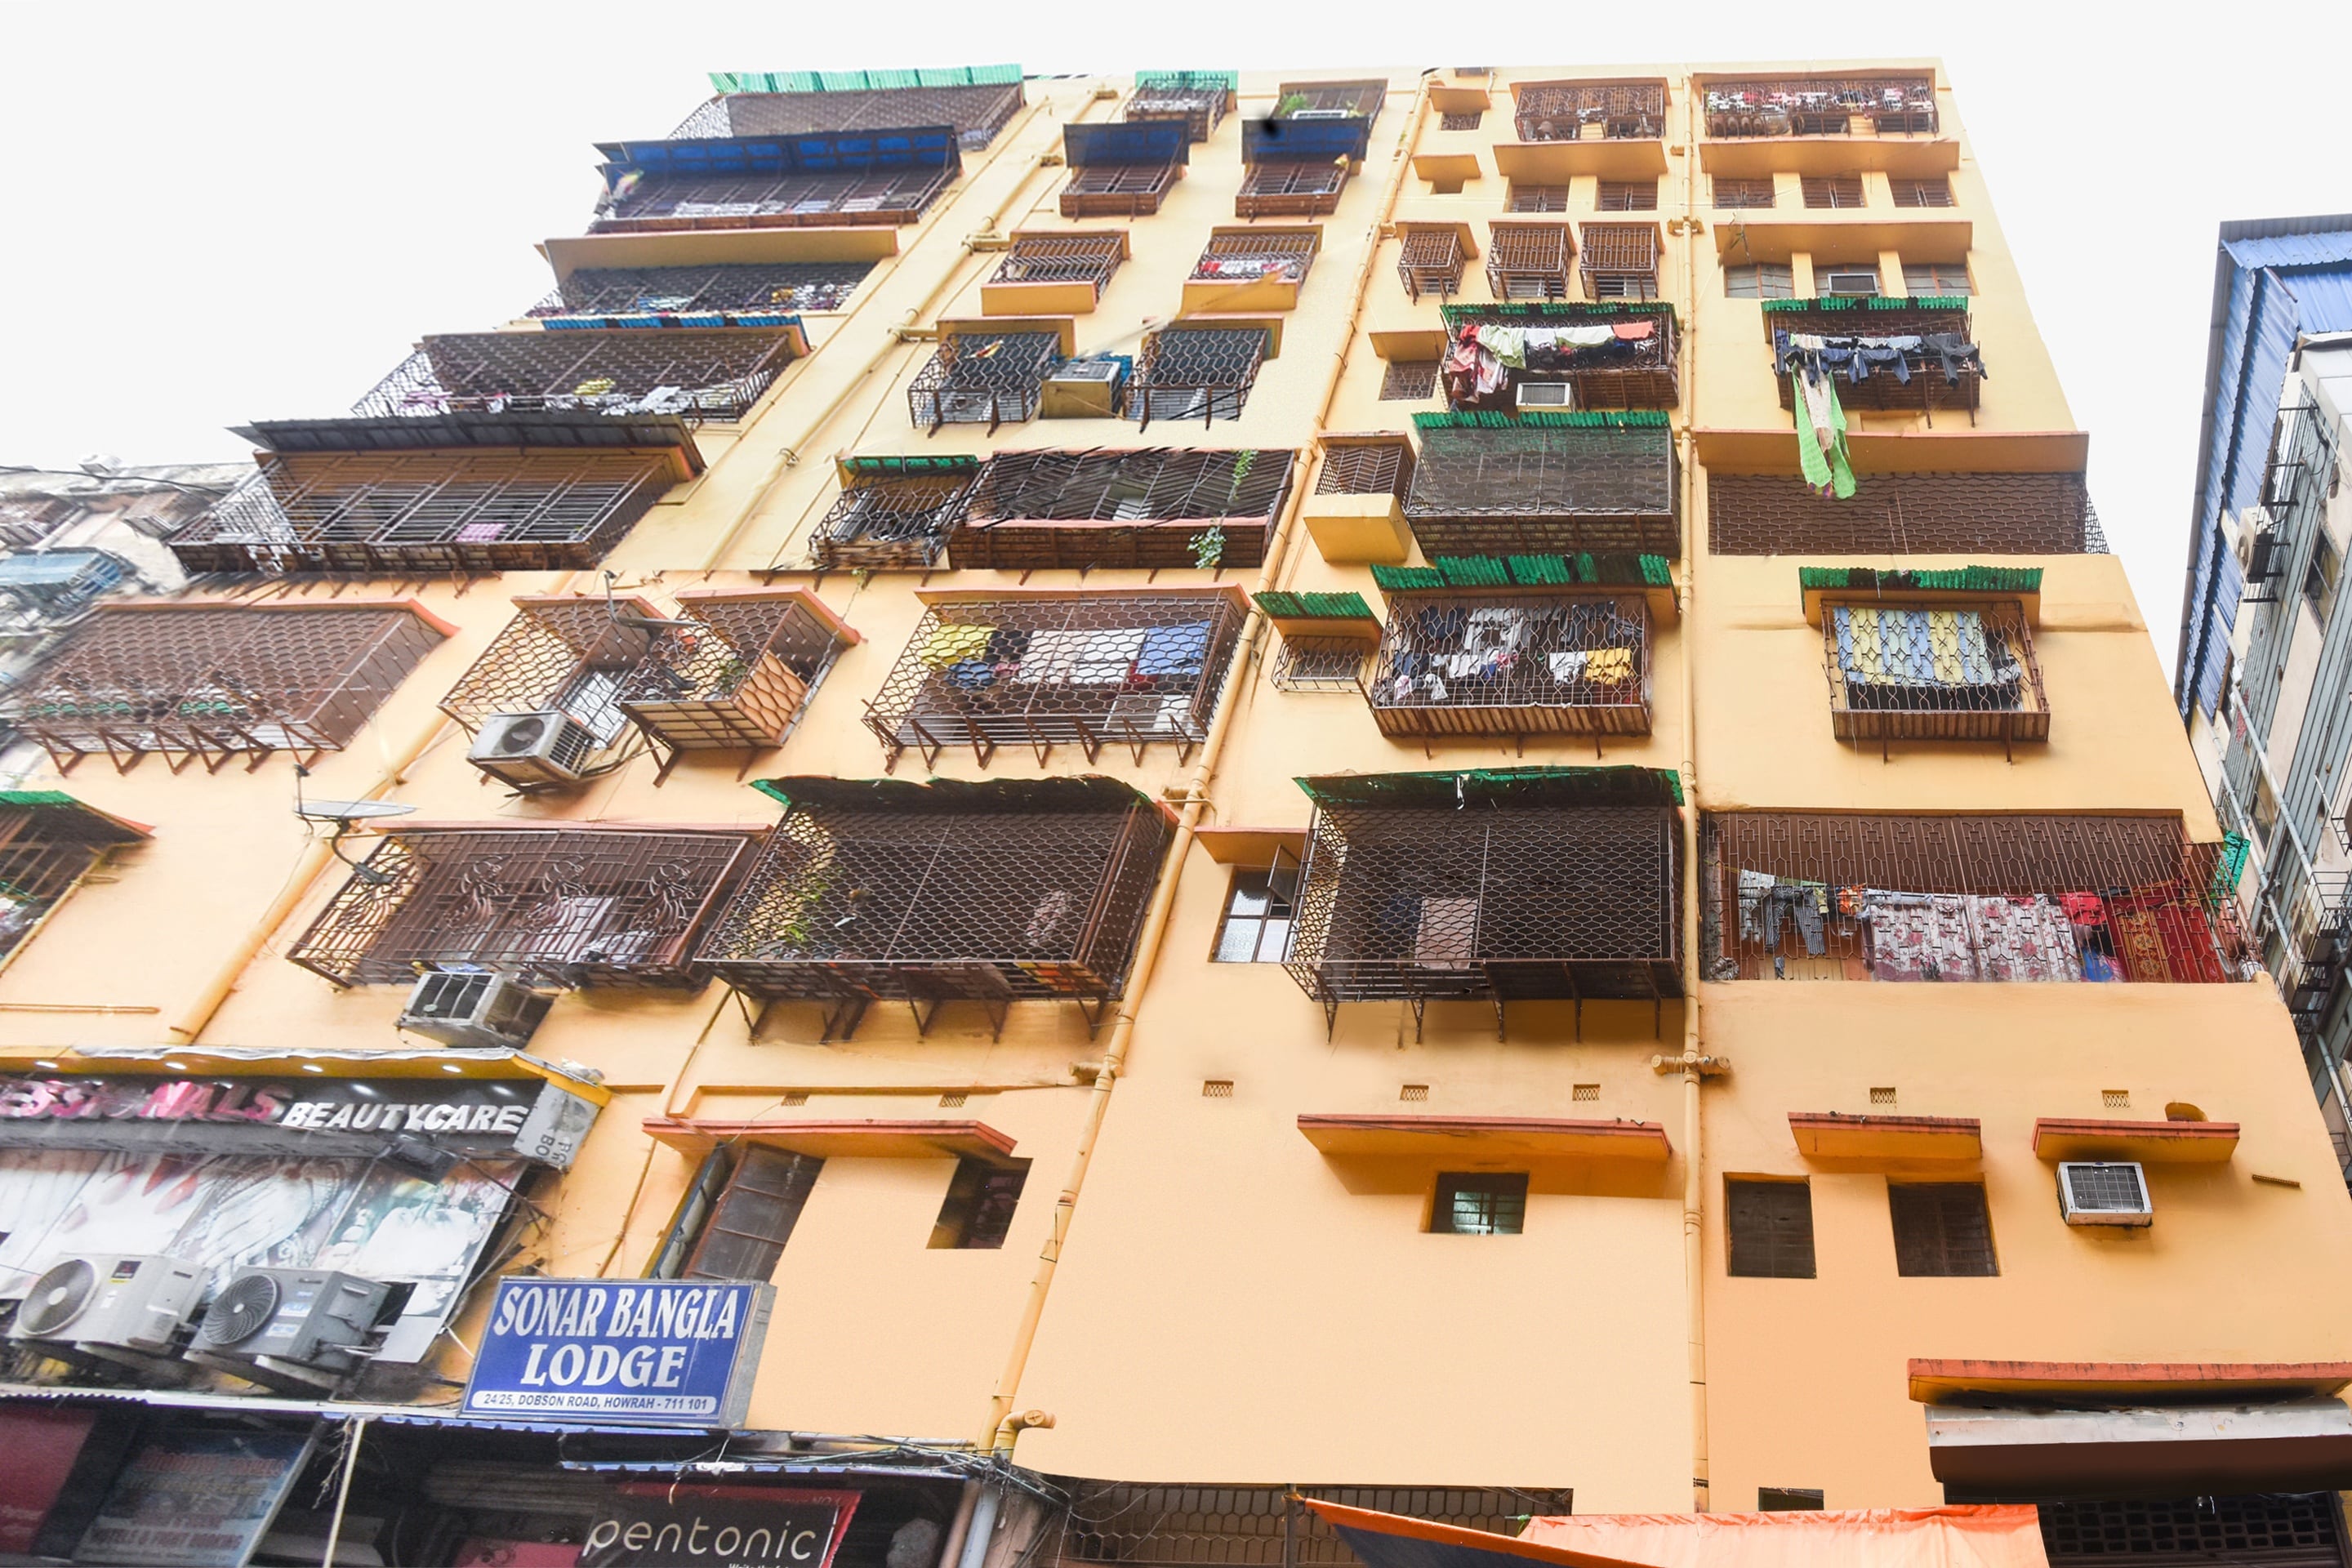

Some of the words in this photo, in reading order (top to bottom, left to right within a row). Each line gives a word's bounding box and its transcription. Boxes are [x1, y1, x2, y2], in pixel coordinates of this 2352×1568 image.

[493, 1286, 607, 1338] SONAR
[606, 1288, 739, 1340] BANGLA
[520, 1343, 687, 1388] LODGE
[519, 1394, 565, 1406] DOBSON
[567, 1396, 600, 1409] ROAD,
[604, 1397, 655, 1409] HOWRAH
[664, 1398, 684, 1410] 711
[688, 1399, 707, 1410] 101
[581, 1517, 816, 1560] pentonic
